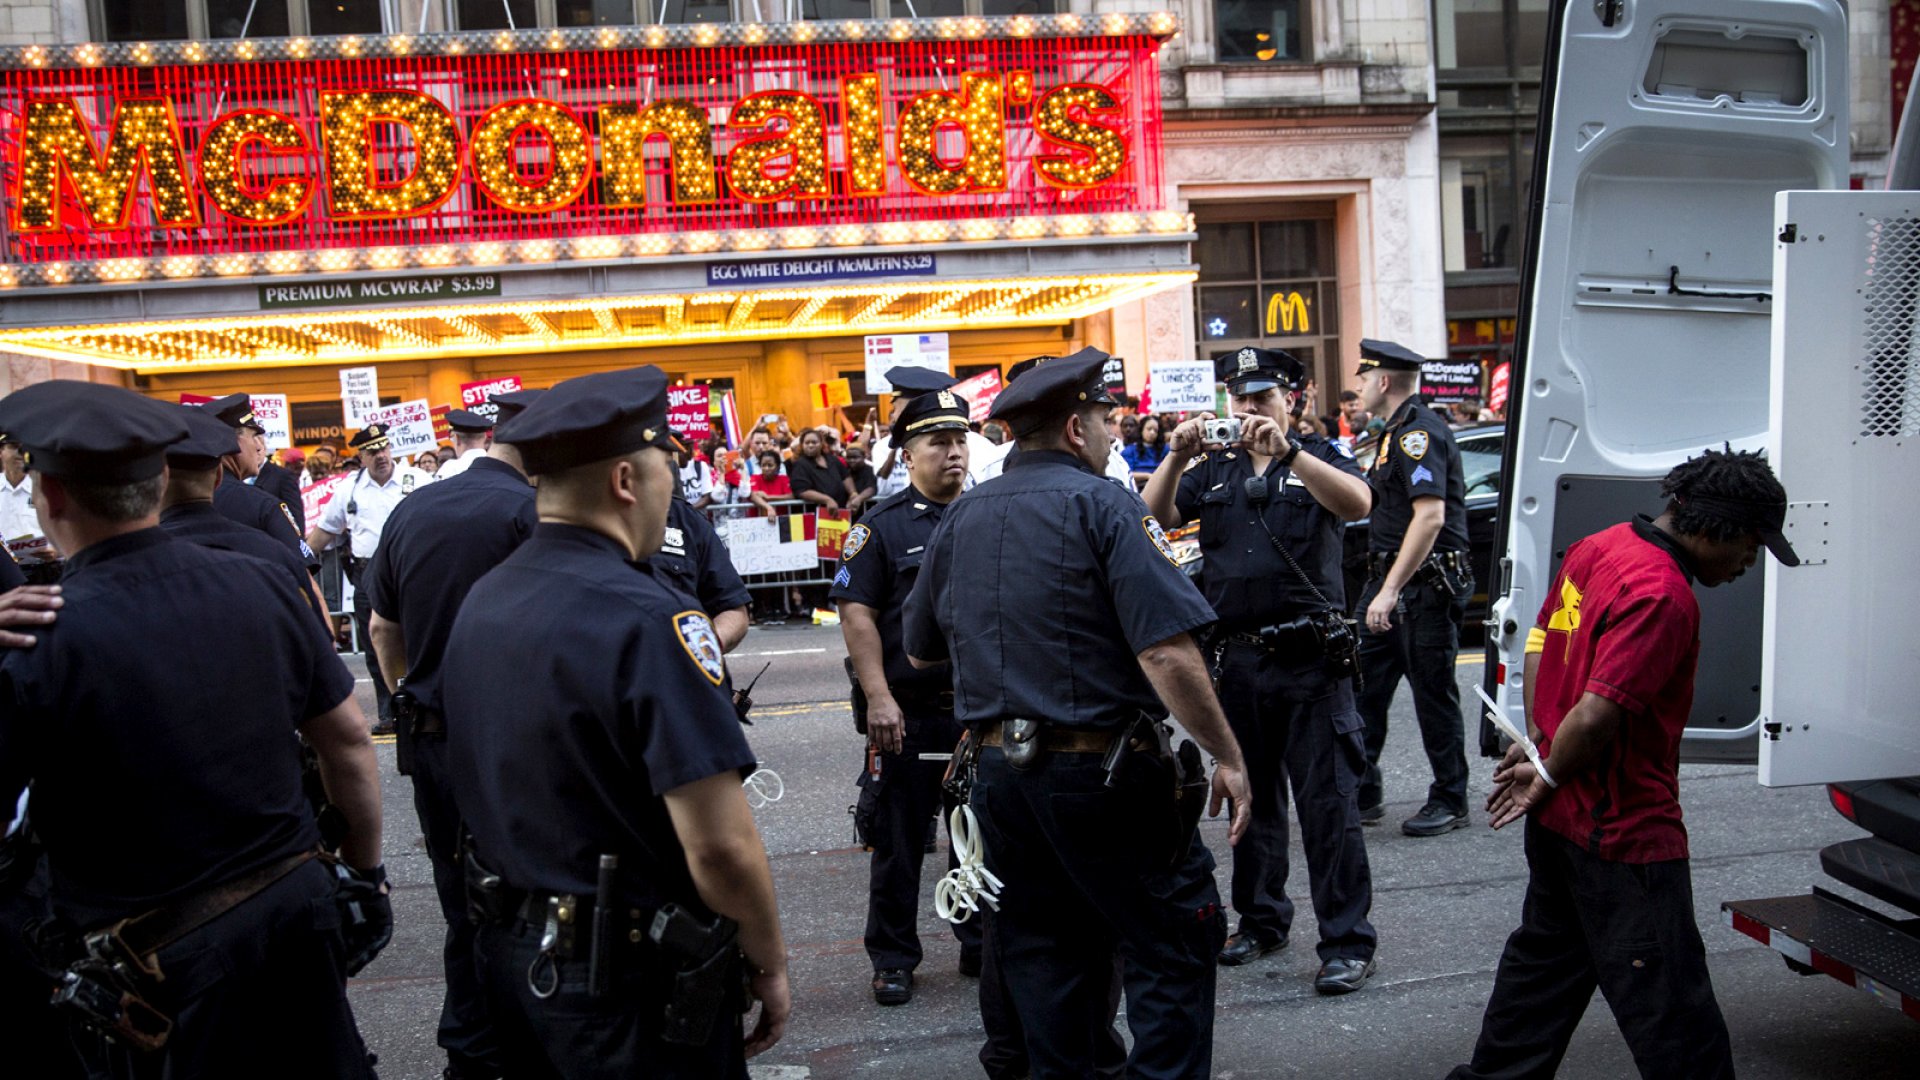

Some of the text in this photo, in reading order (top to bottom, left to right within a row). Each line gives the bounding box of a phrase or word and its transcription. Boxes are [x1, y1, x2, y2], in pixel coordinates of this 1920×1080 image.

[16, 70, 1129, 233] McDonald's
[711, 255, 933, 280] EGG WHITE DELIGHT McMUFFIN $3.29
[265, 275, 496, 302] PREMIUM MCWRAP $3.99
[1161, 373, 1202, 383] UNIDOS
[1421, 361, 1480, 375] McDonald's
[462, 378, 521, 403] STRIKE.
[363, 412, 379, 422] LO
[380, 407, 401, 419] QUE
[403, 403, 426, 415] SEA
[689, 422, 709, 431] NYC
